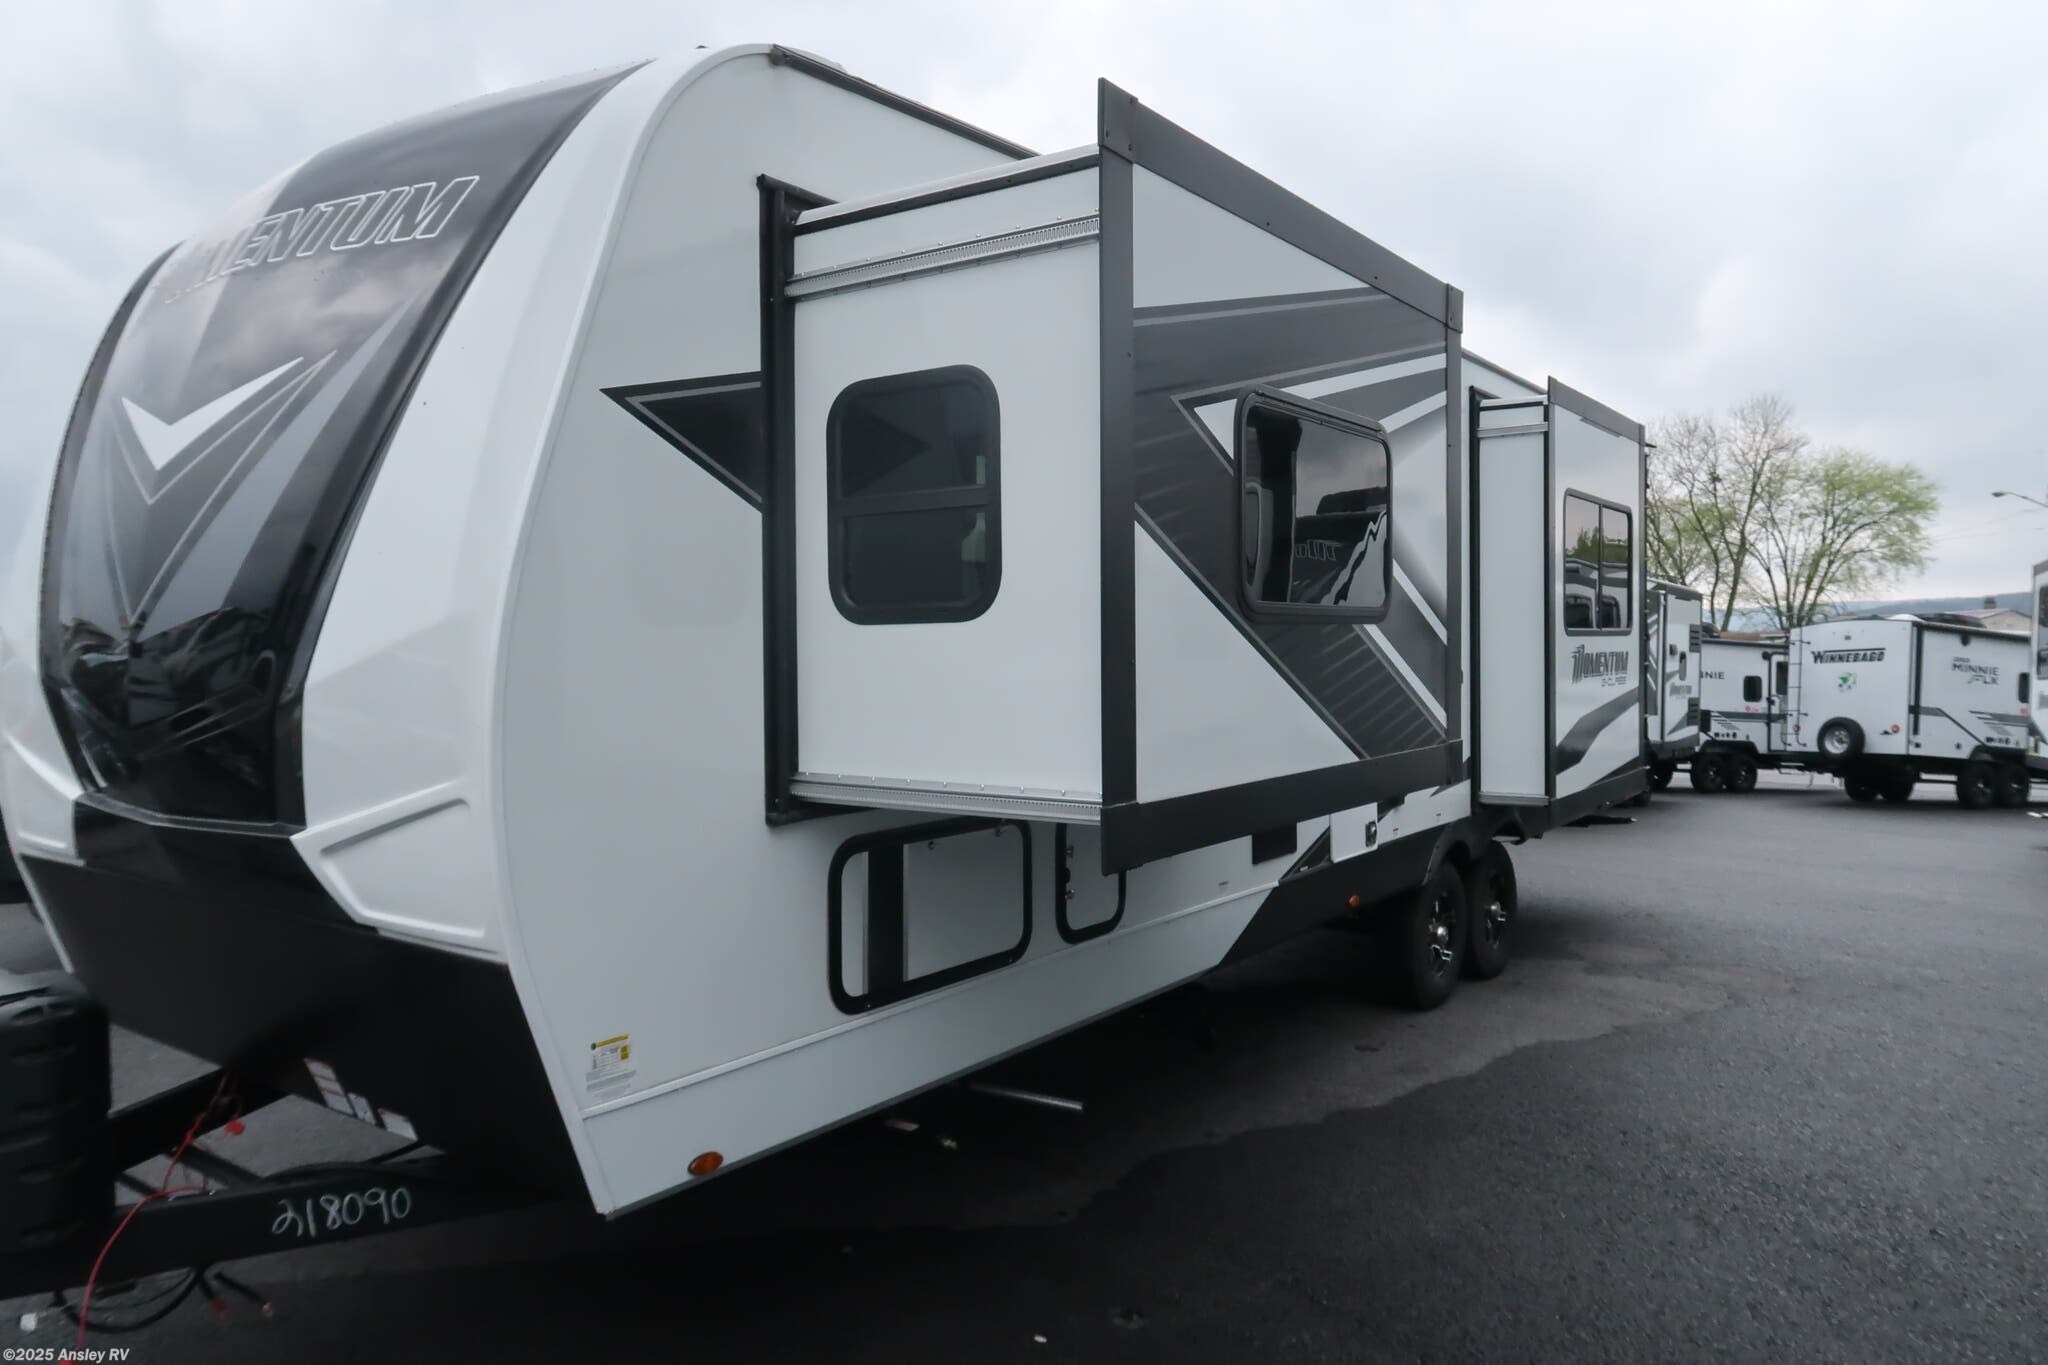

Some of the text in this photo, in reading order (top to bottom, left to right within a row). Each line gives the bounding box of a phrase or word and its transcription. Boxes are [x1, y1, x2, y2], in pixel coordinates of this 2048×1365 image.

[1811, 648, 1886, 664] WINNEBAGO
[1952, 663, 1999, 675] MINNIE
[271, 1185, 412, 1238] 218090
